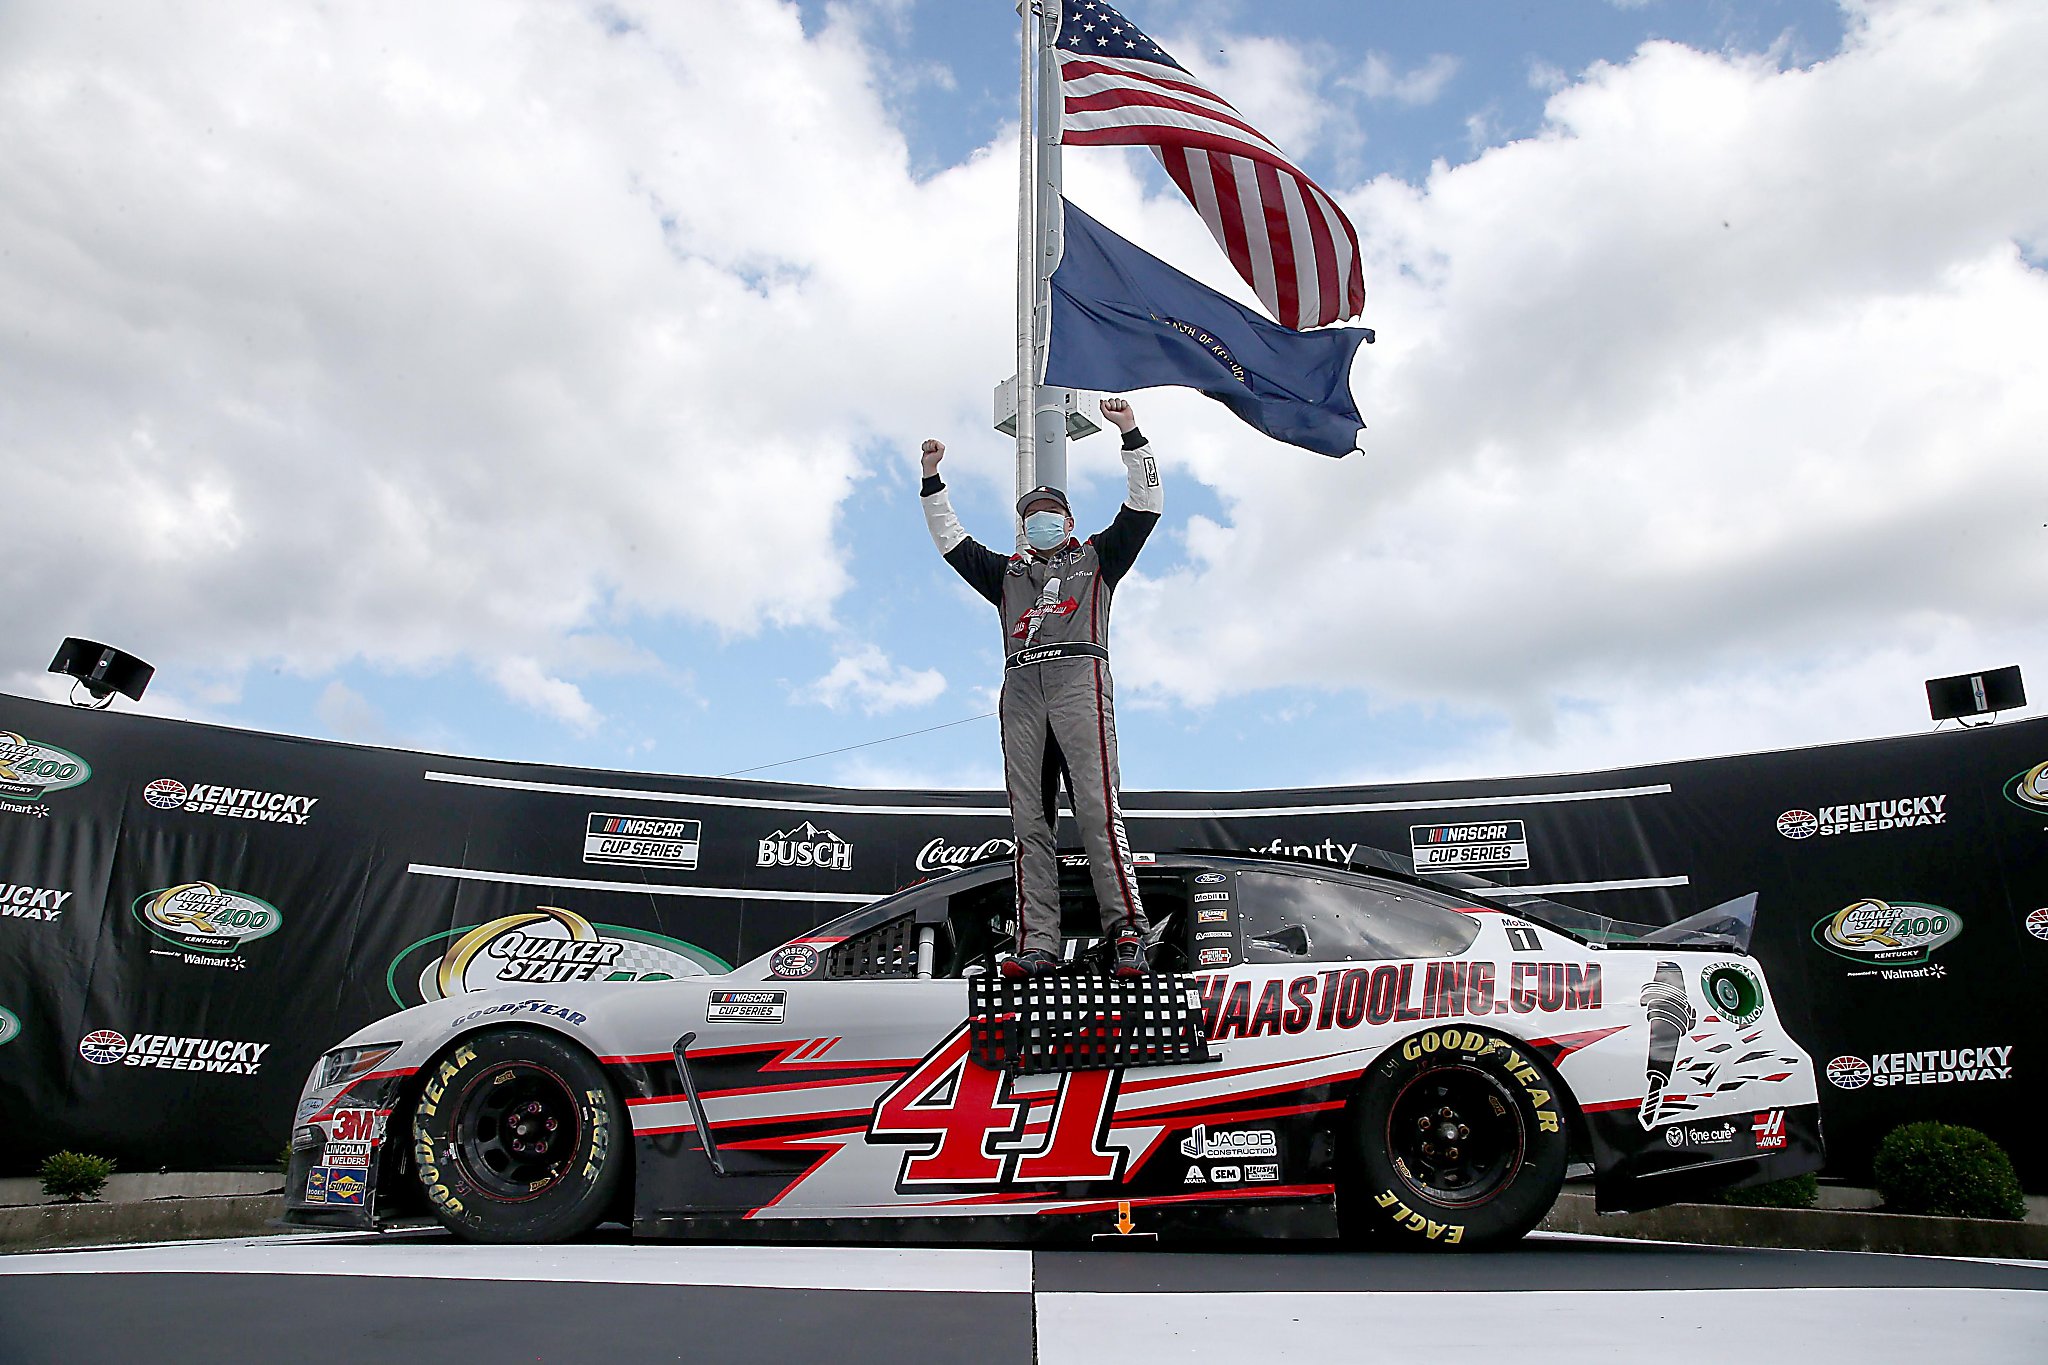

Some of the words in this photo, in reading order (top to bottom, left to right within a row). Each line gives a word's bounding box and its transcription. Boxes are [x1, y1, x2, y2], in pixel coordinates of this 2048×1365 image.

[1199, 334, 1214, 345] OF
[1023, 649, 1062, 662] CUSTER
[15, 757, 80, 781] 400
[187, 783, 319, 814] KENTUCKY
[1818, 794, 1947, 825] KENTUCKY
[622, 819, 685, 838] NASCAR
[1447, 824, 1508, 843] NASCAR
[600, 839, 631, 856] CUP
[631, 841, 684, 858] SERIES
[756, 839, 853, 871] BUSCH
[1428, 848, 1459, 864] CUP
[1460, 845, 1512, 862] SERIES
[175, 890, 232, 907] QUAKER
[1195, 893, 1218, 901] Mobil
[178, 900, 220, 913] STATE
[211, 908, 271, 930] 400
[1847, 908, 1904, 922] QUAKER
[1855, 917, 1893, 930] STATE
[1892, 915, 1950, 937] 400
[183, 935, 230, 946] KENTUCKY
[489, 931, 623, 966] QUAKER
[1514, 929, 1532, 950] 1
[183, 952, 230, 968] Walmart
[779, 947, 813, 959] NASCAR
[1874, 950, 1919, 959] KENTUCKY
[496, 957, 600, 983] STATE
[774, 964, 812, 976] SALUTES
[1701, 962, 1755, 983] AMERICAN
[1880, 966, 1930, 980] Walmart
[734, 993, 775, 1004] NASCAR
[451, 1000, 588, 1028] GOODYEAR
[718, 1005, 740, 1016] CUP
[739, 1006, 774, 1017] SERIES
[1716, 1004, 1764, 1025] ETHANOL
[127, 1033, 271, 1063] KENTUCKY
[1871, 1045, 2013, 1075] KENTUCKY
[1402, 1028, 1560, 1134] GOODYEAR
[864, 1013, 1133, 1196] 41
[332, 1109, 375, 1141] 3M
[412, 1041, 478, 1218] GOODYEAR
[582, 1088, 610, 1186] EAGLE
[1207, 1132, 1275, 1148] JACOB
[1691, 1129, 1710, 1142] one
[1711, 1129, 1732, 1140] cure
[1756, 1136, 1786, 1147] HAAS
[325, 1143, 365, 1155] LINCOLN
[1206, 1147, 1276, 1157] CONSTRUCTION
[331, 1156, 367, 1165] WELDERS
[1215, 1169, 1237, 1180] SEM
[1249, 1166, 1275, 1175] RUSH
[329, 1181, 365, 1192] SUNOCO
[1373, 1188, 1466, 1244] EAGLE
